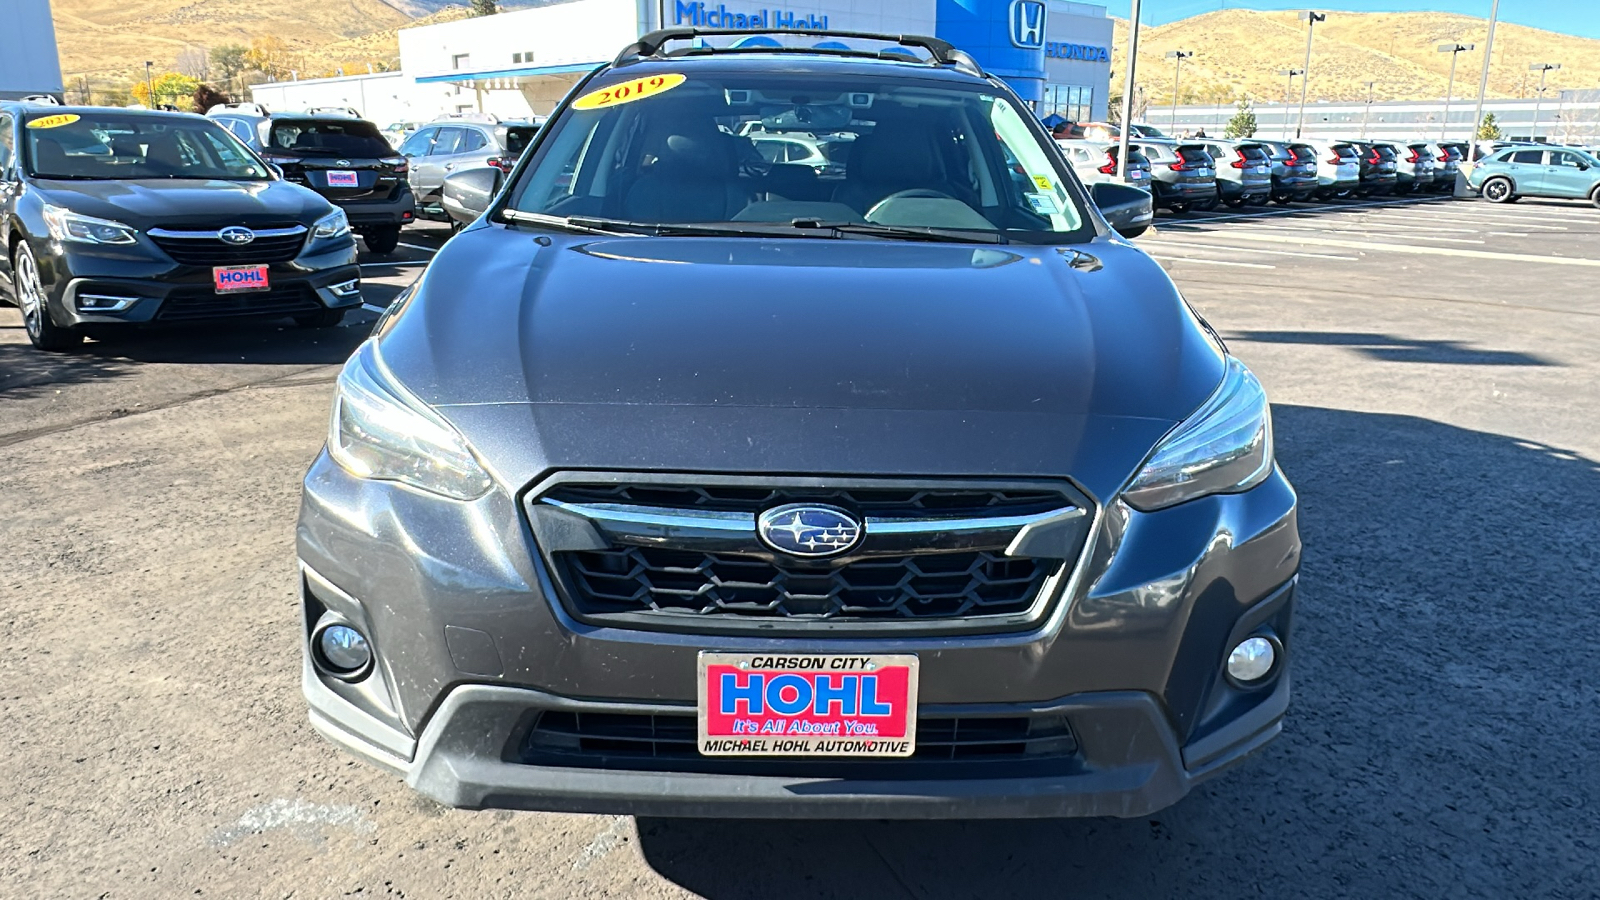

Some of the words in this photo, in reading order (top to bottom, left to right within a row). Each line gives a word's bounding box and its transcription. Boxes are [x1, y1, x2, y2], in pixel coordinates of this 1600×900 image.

[673, 0, 768, 29] Michael
[773, 10, 829, 31] Hohl
[1046, 42, 1110, 63] HONDA
[597, 77, 665, 106] 2019
[38, 115, 69, 128] 2021
[219, 270, 264, 283] HOHL
[751, 657, 827, 669] CARSON
[831, 657, 870, 669] CITY
[720, 673, 892, 716] HOHL
[733, 719, 758, 733] It's
[763, 719, 785, 734] All
[788, 720, 840, 734] About
[845, 720, 878, 734] You.
[704, 740, 768, 752] MICHAEL
[772, 740, 811, 753] HOHL
[815, 741, 909, 753] AUTOMOTIVE
